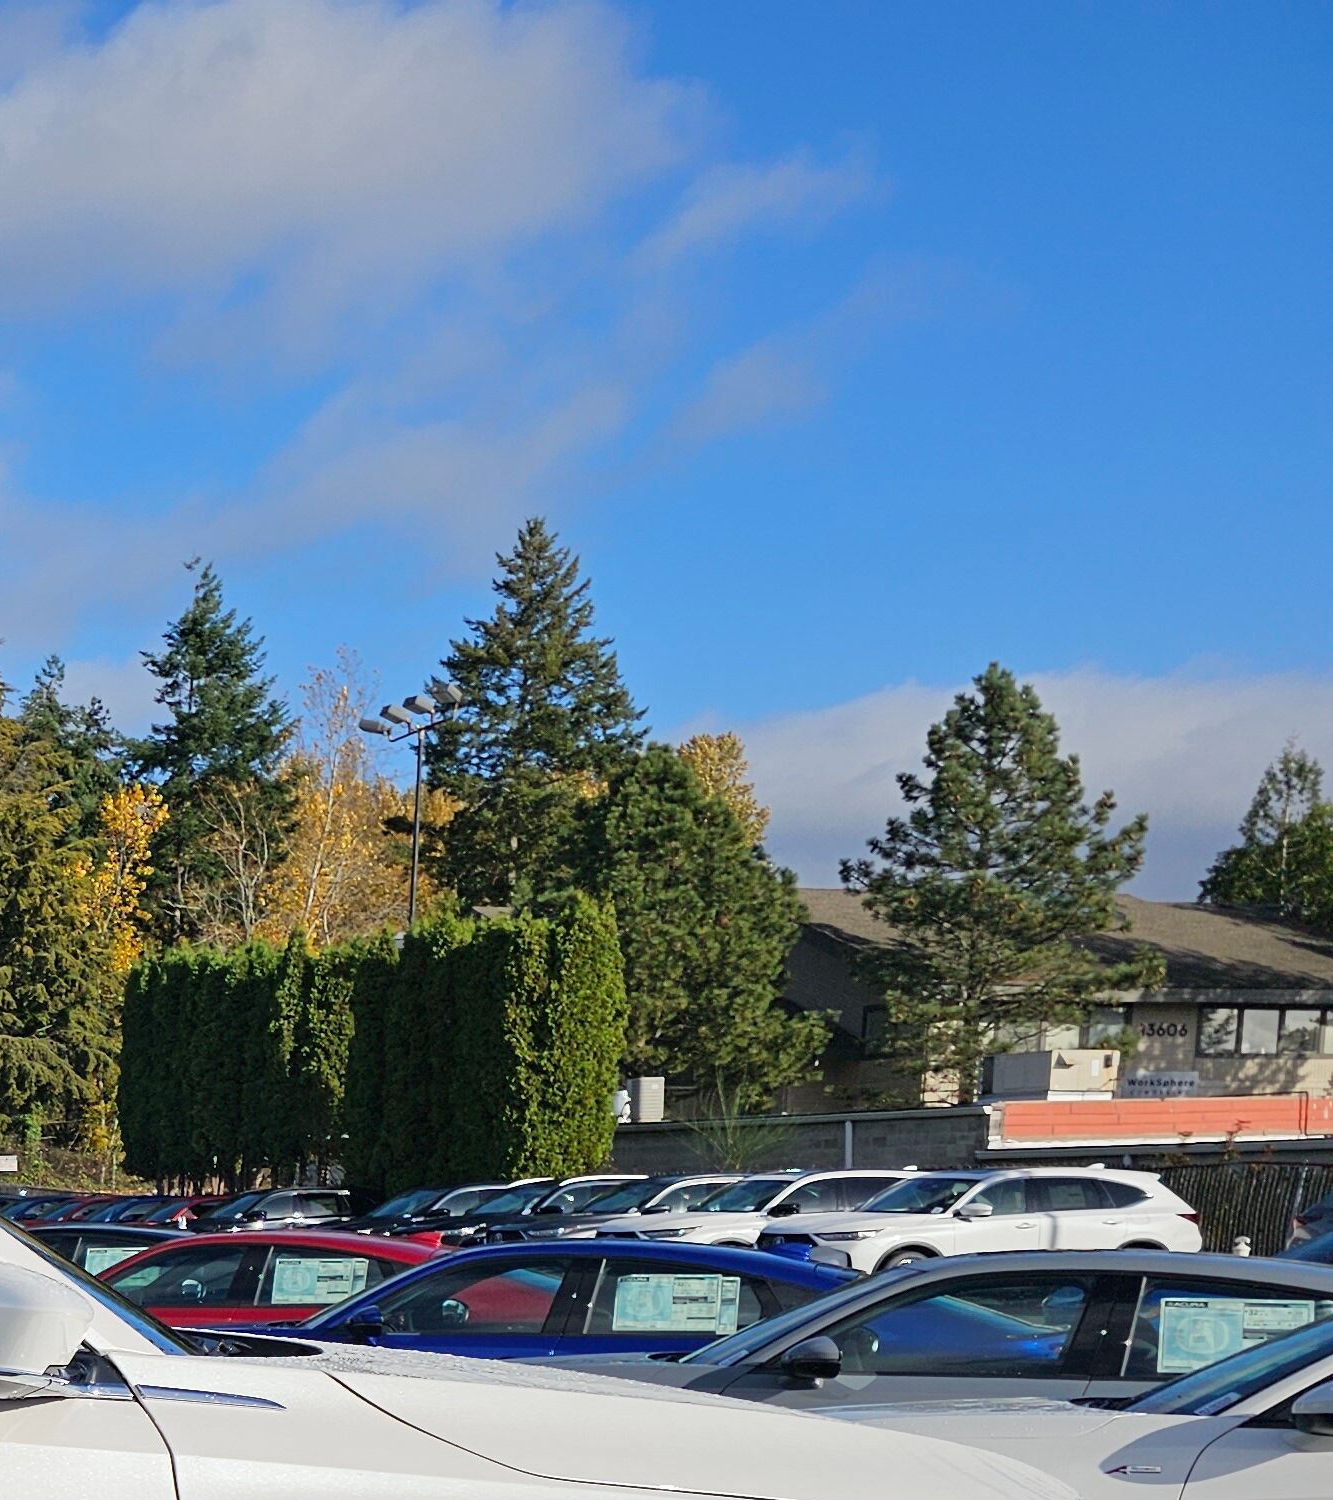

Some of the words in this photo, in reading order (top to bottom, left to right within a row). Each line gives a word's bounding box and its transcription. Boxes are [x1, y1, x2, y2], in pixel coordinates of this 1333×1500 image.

[1140, 1023, 1188, 1037] 13606
[1127, 1079, 1195, 1088] WorkSphere
[1174, 1301, 1207, 1309] ACURA
